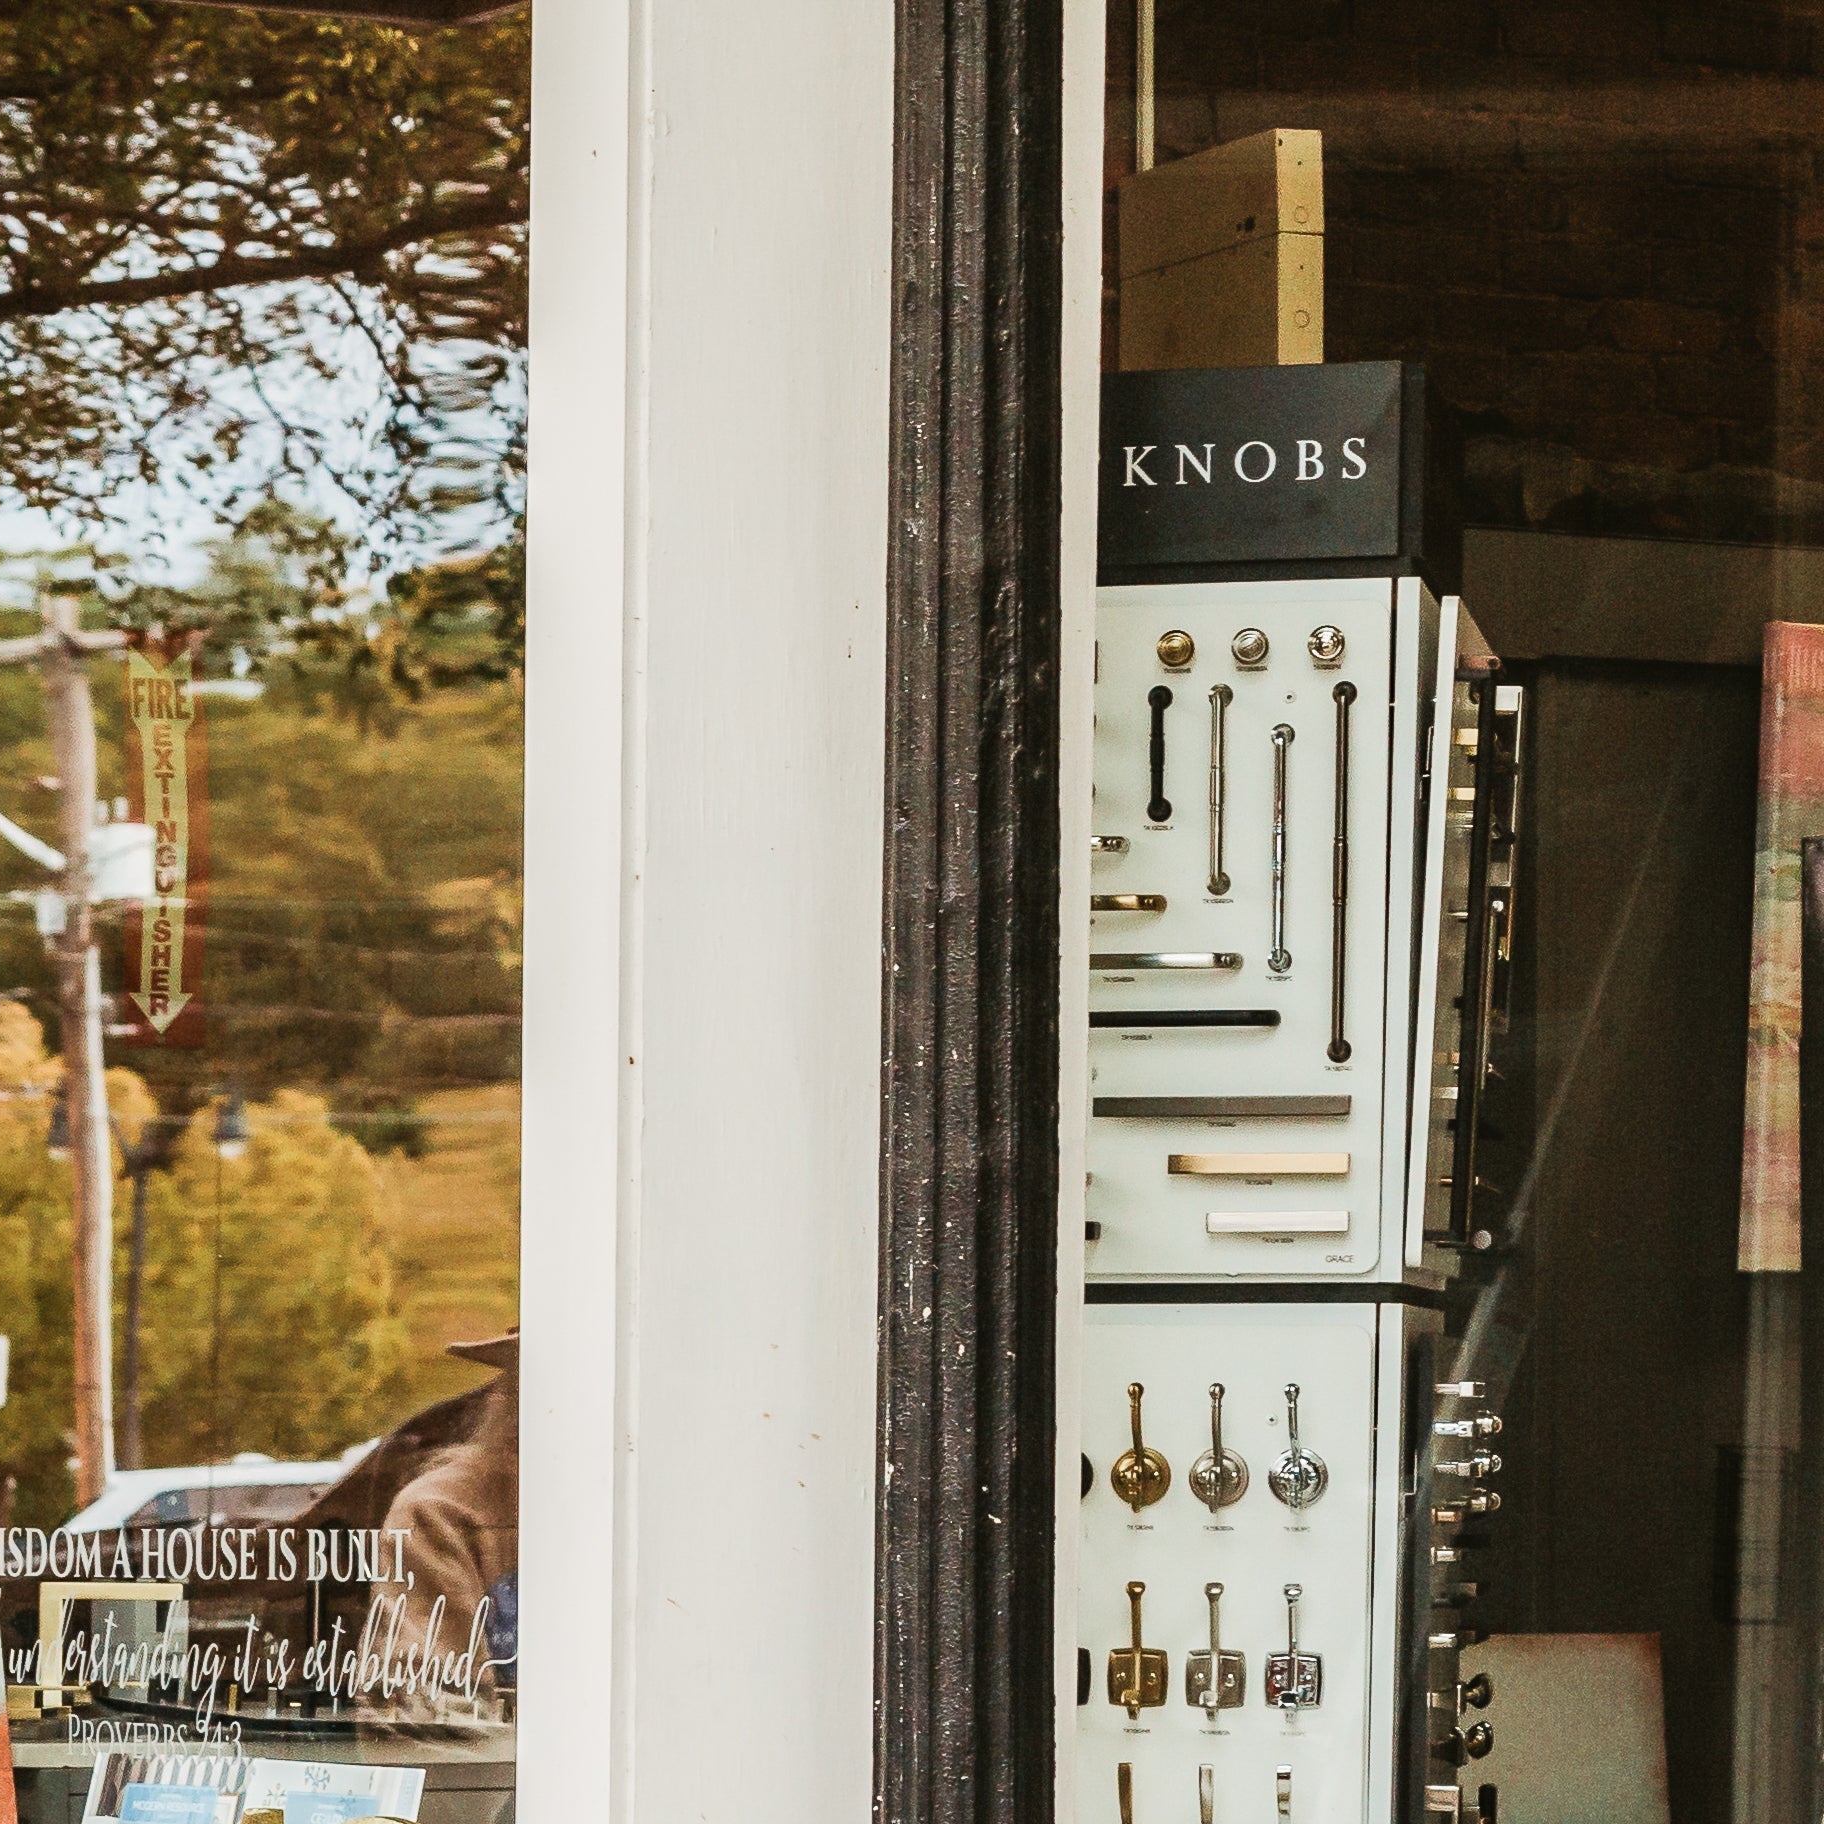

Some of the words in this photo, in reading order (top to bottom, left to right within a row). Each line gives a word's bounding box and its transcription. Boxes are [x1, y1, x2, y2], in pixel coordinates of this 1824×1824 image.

[1123, 437, 1369, 488] KNOBS
[132, 677, 190, 721] FIRE
[149, 723, 180, 1019] EXTINGUISHER
[111, 1527, 133, 1580] A
[140, 1527, 257, 1582] HOUSE
[266, 1528, 297, 1582] IS
[306, 1528, 415, 1591] BUILT,
[9, 1590, 226, 1733] understanding
[234, 1612, 261, 1695] it
[267, 1630, 295, 1693] is
[303, 1593, 517, 1702] established
[68, 1713, 188, 1760] PROVERBS
